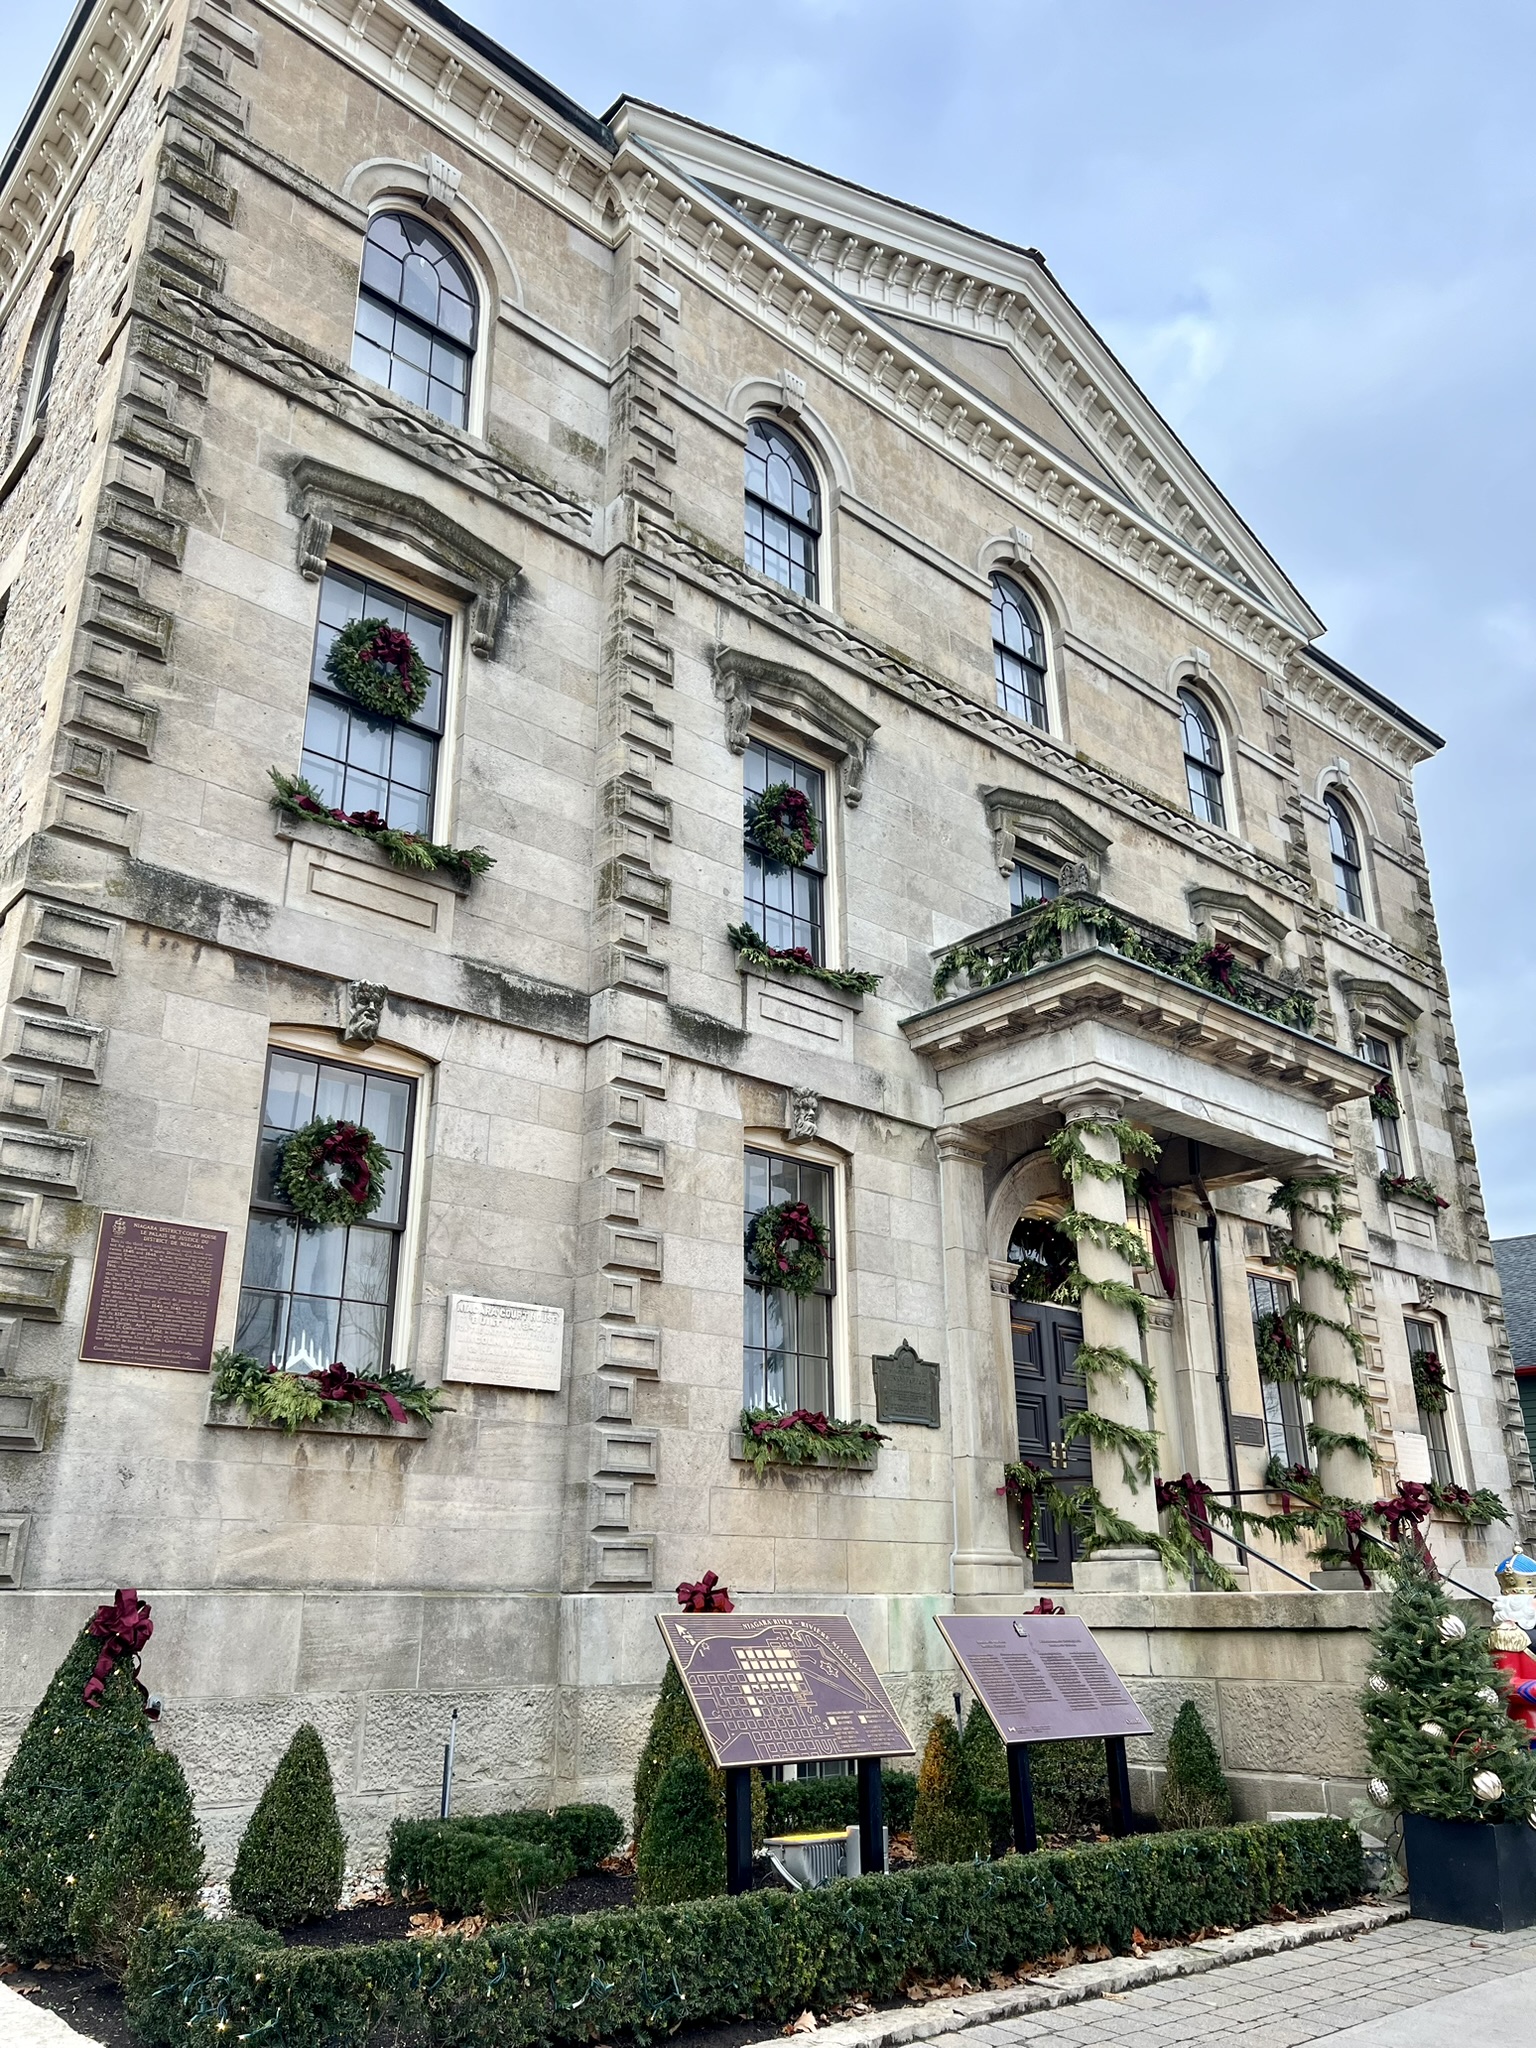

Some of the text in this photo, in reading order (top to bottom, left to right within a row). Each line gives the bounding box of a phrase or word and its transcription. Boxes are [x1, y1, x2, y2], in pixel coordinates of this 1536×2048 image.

[133, 1223, 217, 1241] NIAGARA DISTRICT COURT HOUSE
[178, 1235, 199, 1243] JUSTICE
[143, 1236, 168, 1244] DISTRICT
[180, 1241, 204, 1250] NIAGARA
[457, 1303, 558, 1325] NIAGARA COURT HOUSE
[471, 1316, 502, 1328] BUILT
[741, 1619, 772, 1630] NIAGARA
[772, 1618, 793, 1626] RIVER
[832, 1641, 862, 1673] NIAGARA
[822, 1721, 830, 1731] 3
